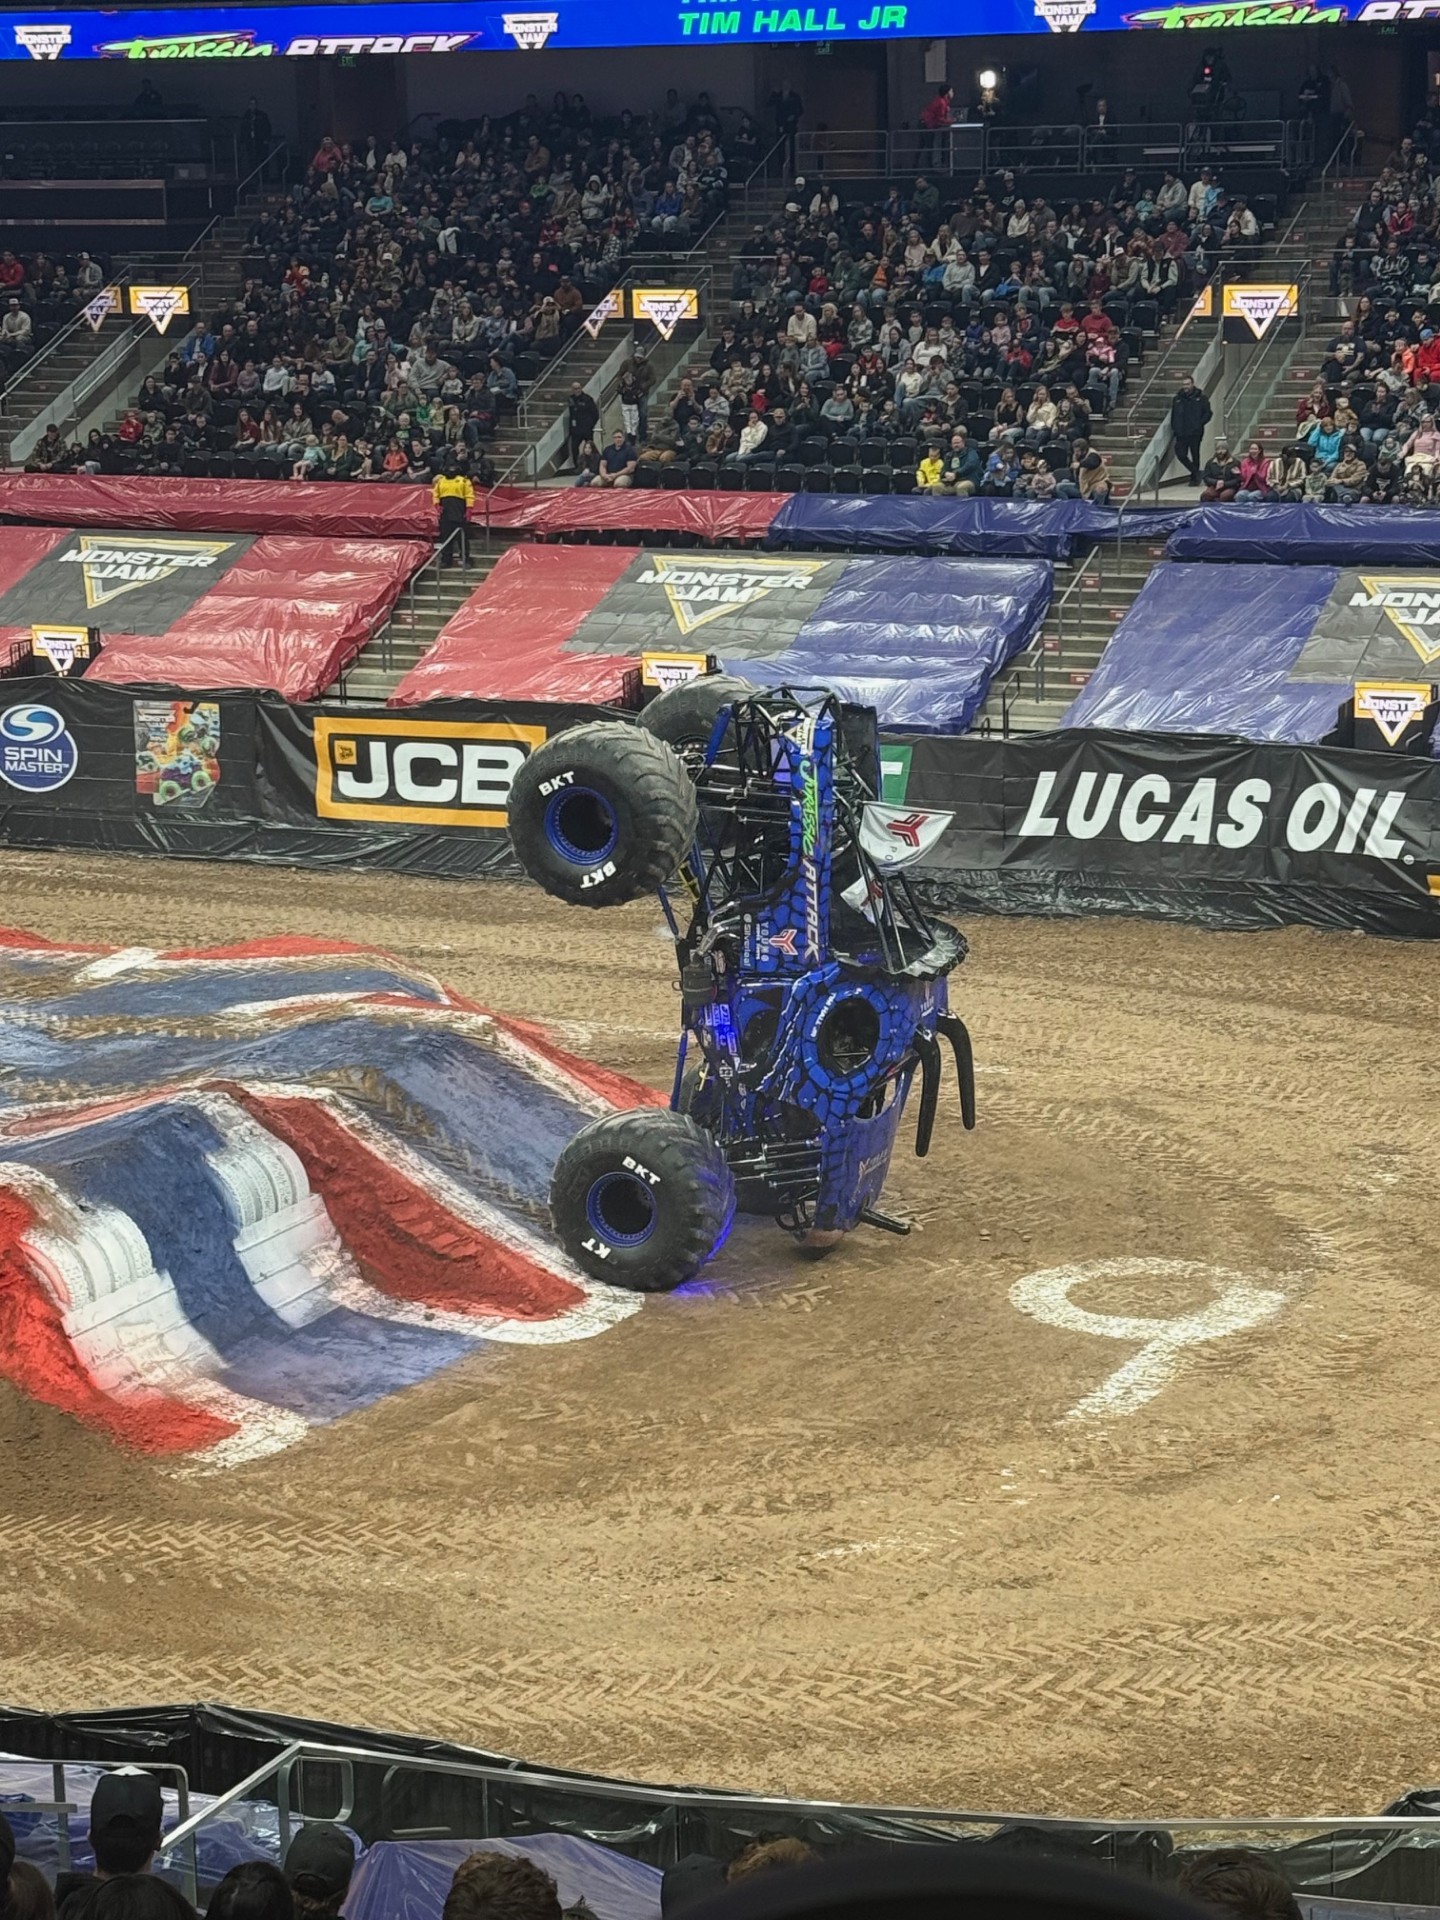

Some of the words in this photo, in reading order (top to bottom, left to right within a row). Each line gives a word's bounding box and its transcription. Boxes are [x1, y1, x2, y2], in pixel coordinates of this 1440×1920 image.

[678, 11, 741, 35] TIM
[752, 8, 846, 33] HALL
[858, 5, 907, 29] JR
[1034, 4, 1096, 16] MONSTER
[503, 22, 557, 32] MONSTER
[58, 549, 218, 568] MONSTER
[87, 563, 163, 581] JAM
[636, 570, 813, 590] MONSTER
[671, 585, 754, 603] JAM
[1358, 699, 1427, 711] MONSTER
[5, 747, 63, 762] SPIN
[336, 741, 526, 805] JCB
[538, 771, 575, 796] BKT
[799, 760, 819, 857] JURASSIC
[1019, 771, 1272, 849] LUCAS
[1285, 782, 1408, 859] OIL
[580, 861, 617, 889] BKT
[802, 857, 821, 962] ATTACK
[621, 1156, 661, 1186] BKT
